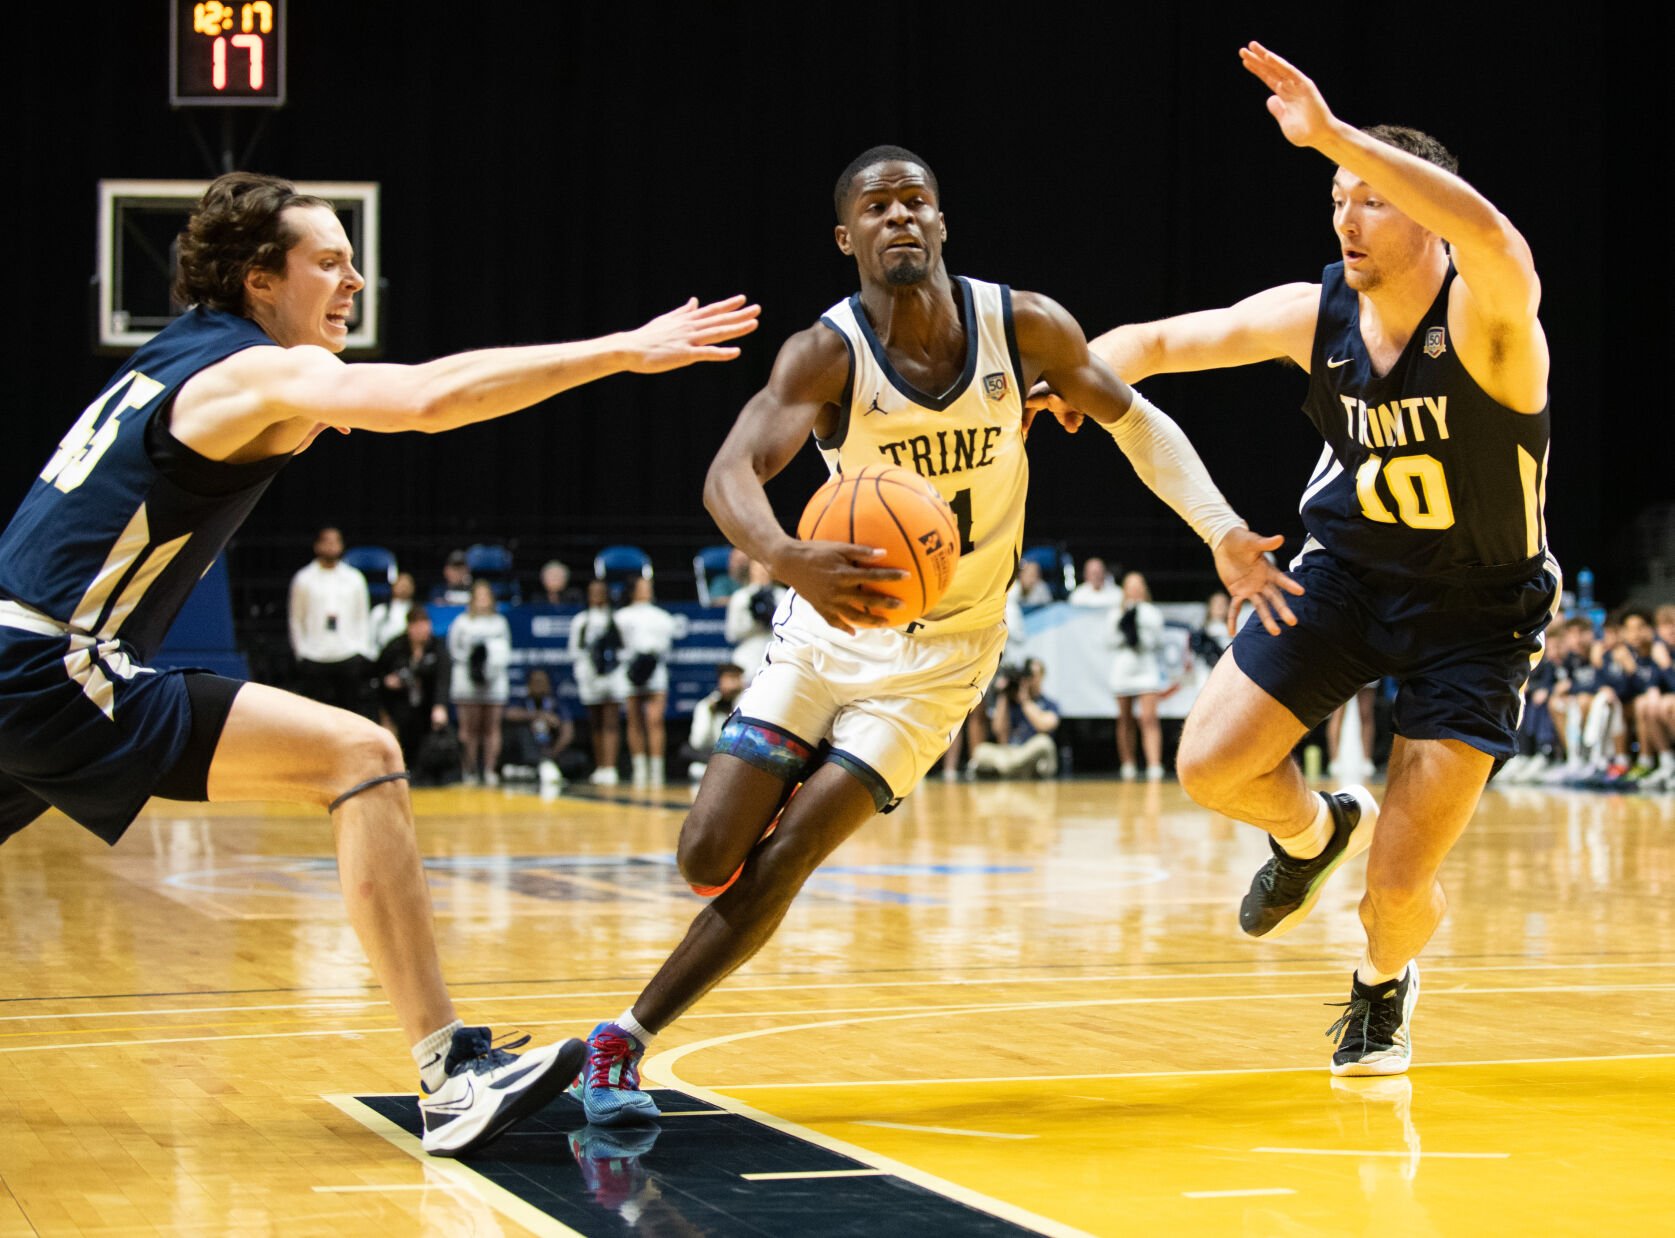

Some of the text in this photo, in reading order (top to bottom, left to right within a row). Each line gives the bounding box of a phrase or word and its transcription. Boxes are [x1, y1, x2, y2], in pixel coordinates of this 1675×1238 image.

[212, 34, 264, 90] 17
[988, 378, 1003, 391] 50
[878, 426, 1002, 477] TRINE
[1355, 453, 1456, 530] 10
